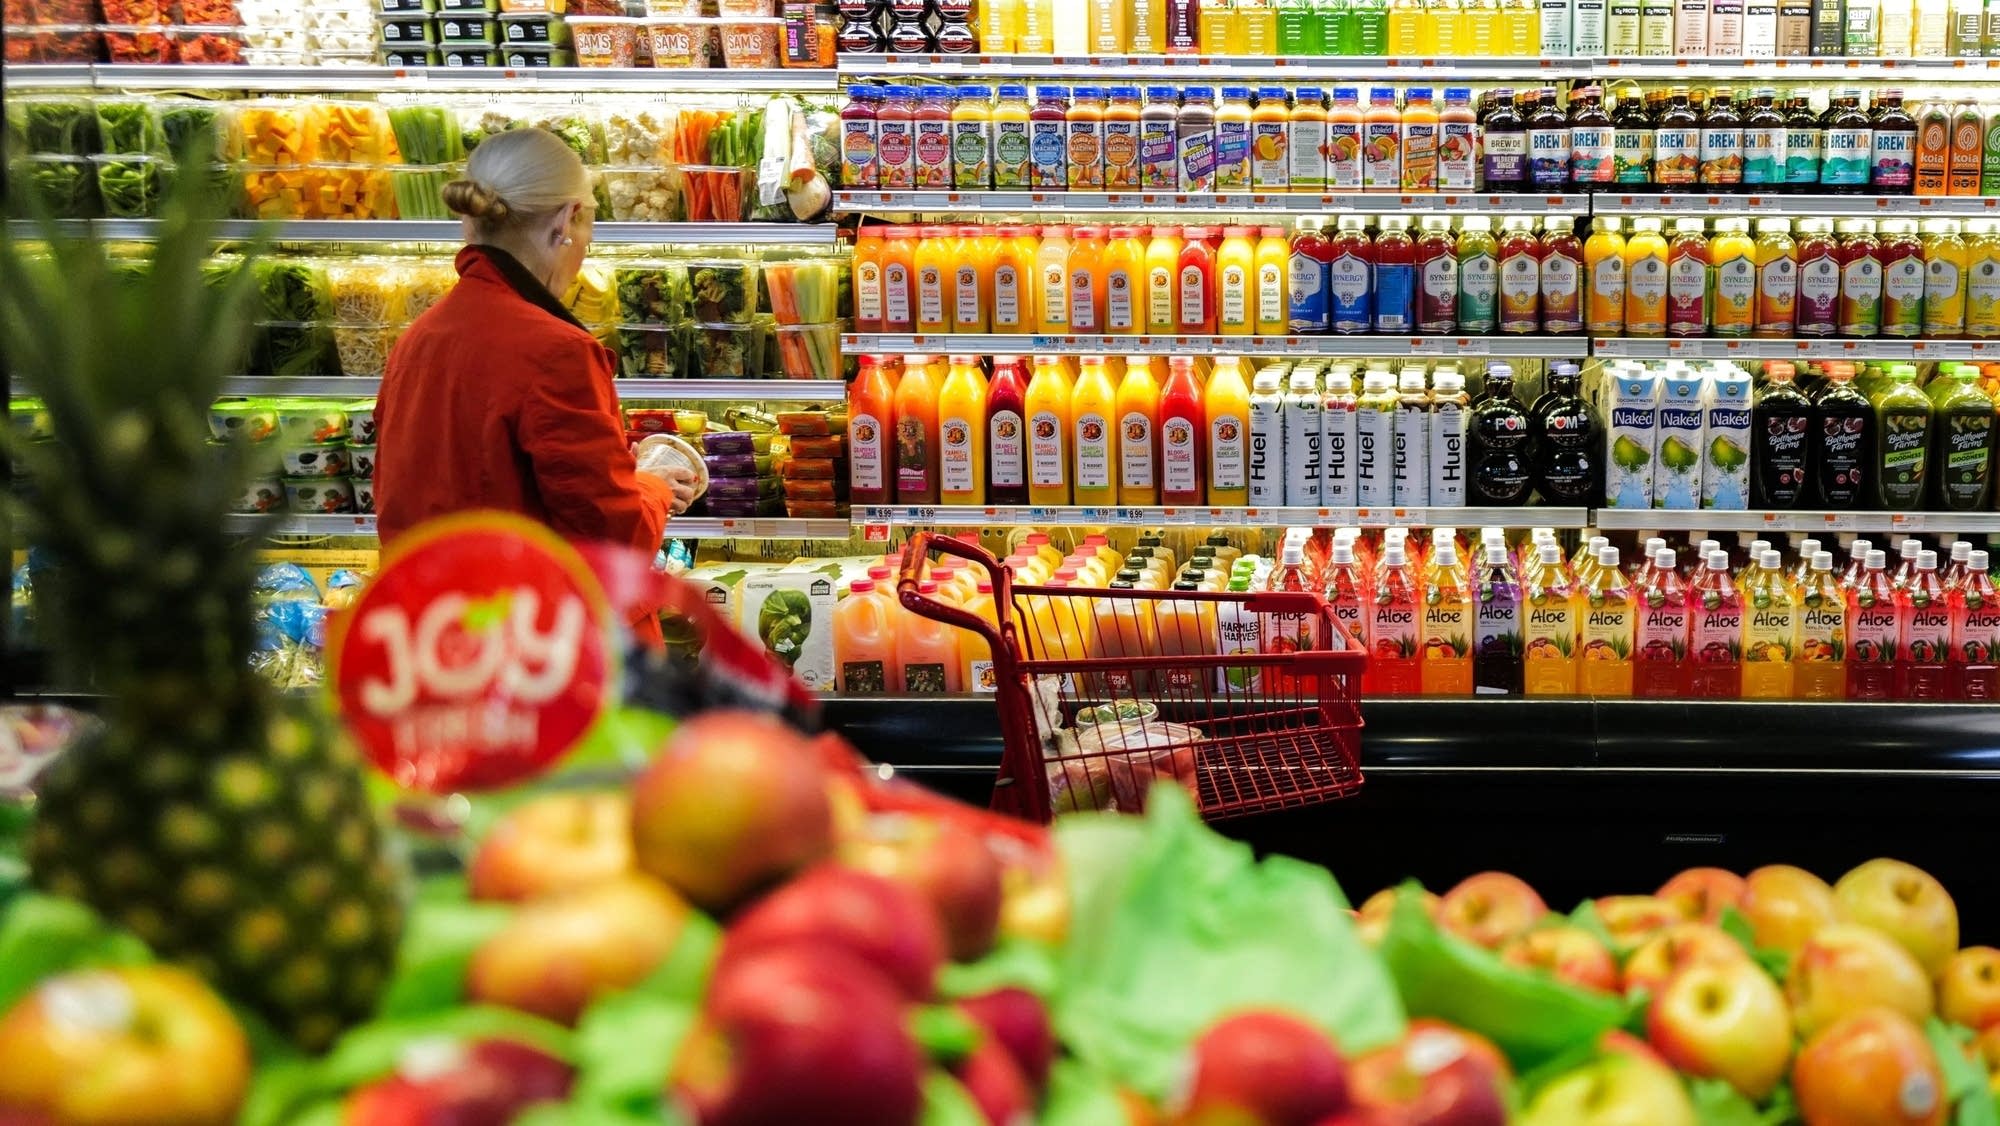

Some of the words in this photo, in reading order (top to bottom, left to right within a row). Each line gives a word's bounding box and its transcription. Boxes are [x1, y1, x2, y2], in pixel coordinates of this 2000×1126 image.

[579, 34, 611, 48] SAM'S
[655, 34, 688, 48] SAM'S
[728, 34, 761, 48] SAM'S
[1491, 140, 1510, 148] BREW
[1534, 135, 1560, 148] BREW
[1574, 133, 1599, 146] BREW
[1615, 135, 1640, 148] BREW
[1660, 134, 1684, 148] BREW
[1708, 134, 1736, 148] BREW
[1744, 134, 1756, 148] EW
[1757, 134, 1774, 148] DR.
[1788, 134, 1814, 148] BREW
[1815, 135, 1822, 148] D
[1831, 134, 1856, 148] BREW
[1878, 136, 1904, 150] BREW
[1920, 152, 1944, 163] koia
[1954, 152, 1979, 163] koia
[1985, 153, 1999, 164] ko
[1495, 415, 1526, 430] POM
[1546, 416, 1578, 430] POM
[1615, 411, 1653, 425] Naked
[1664, 412, 1700, 426] Naked
[1712, 412, 1749, 426] Naked
[1769, 433, 1805, 446] Bolthouse
[1825, 433, 1861, 446] Bolthouse
[1888, 431, 1924, 444] Bolthouse
[1894, 439, 1918, 450] Farms
[1952, 431, 1988, 444] Bolthouse
[1958, 439, 1982, 450] Farms
[1776, 441, 1800, 452] Farms
[1832, 441, 1856, 452] Farms
[1251, 433, 1266, 480] Huel
[1304, 432, 1320, 480] Huel
[1328, 432, 1344, 479] Huel
[1360, 432, 1374, 479] Huel
[1443, 434, 1460, 480] Huel
[1888, 452, 1922, 462] GOODNESS
[1952, 452, 1985, 462] GOODNESS
[1335, 606, 1358, 619] loe
[1376, 608, 1412, 622] Aloe
[1426, 608, 1461, 622] Aloe
[1480, 606, 1514, 620] Aloe
[1531, 608, 1566, 624] Aloe
[1589, 611, 1623, 626] Aloe
[1647, 612, 1683, 627] Aloe
[1754, 612, 1789, 626] Aloe
[1805, 610, 1842, 626] Aloe
[1858, 612, 1894, 626] Aloe
[1912, 612, 1948, 626] Aloe
[1966, 612, 2000, 627] Aloe
[1221, 621, 1259, 632] HARMLES
[1704, 612, 1739, 628] Aloe
[1224, 632, 1259, 642] HARVEST
